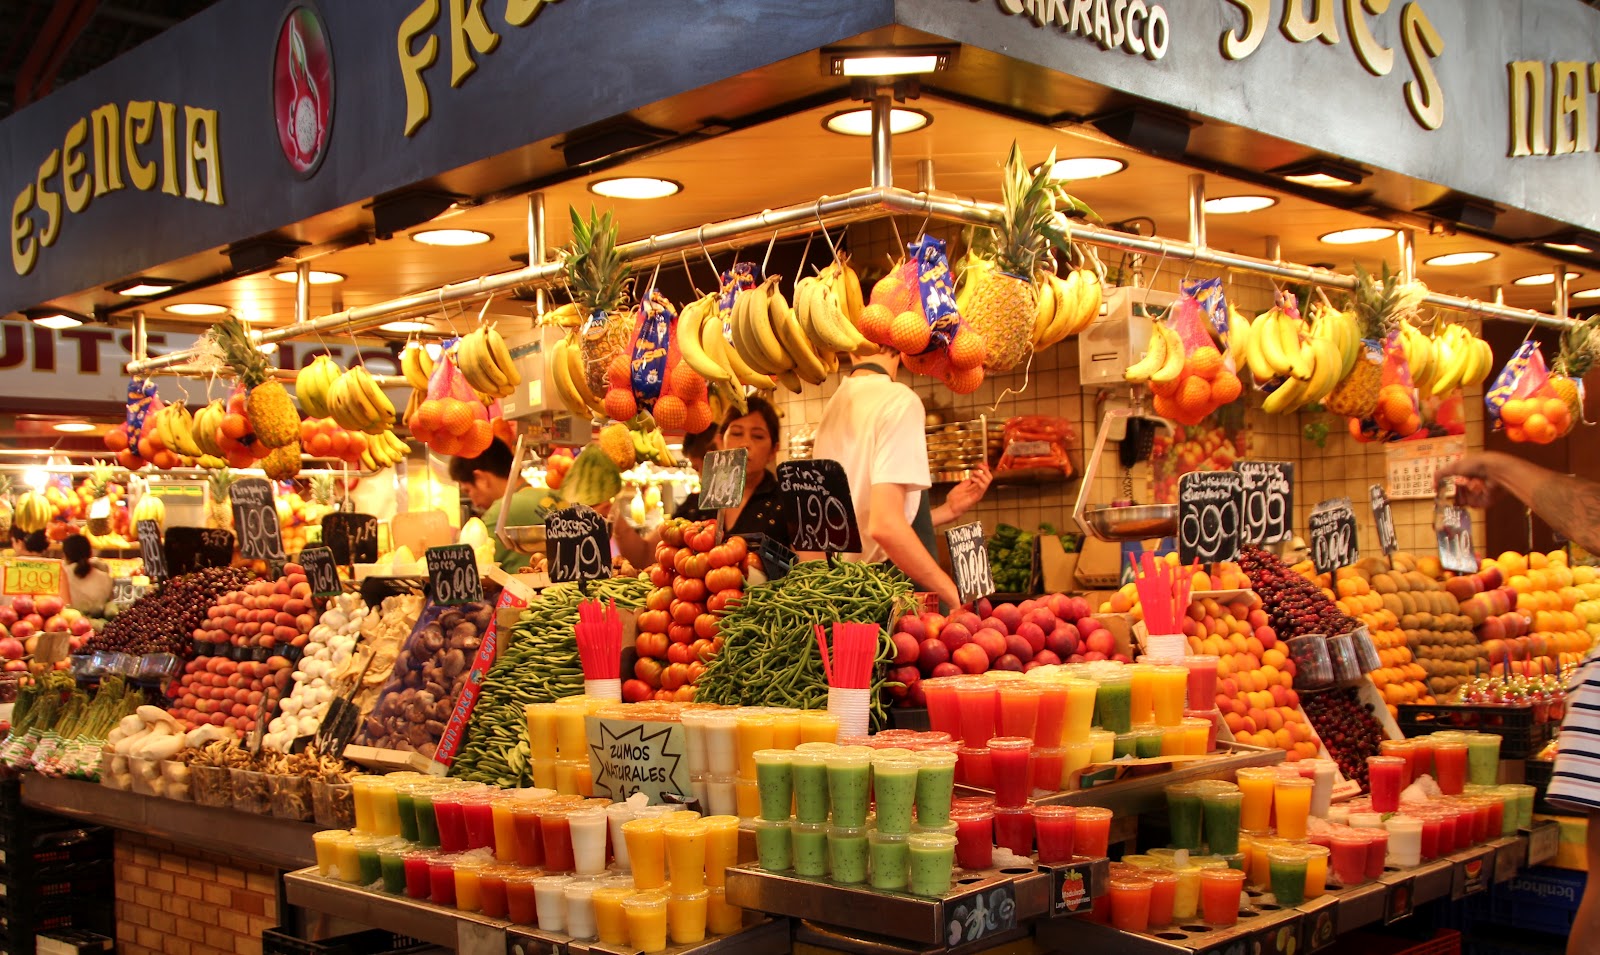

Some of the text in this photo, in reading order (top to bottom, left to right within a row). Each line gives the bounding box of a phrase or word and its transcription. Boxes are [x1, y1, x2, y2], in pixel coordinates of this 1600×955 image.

[1508, 60, 1600, 158] NA
[11, 100, 225, 276] ESENCIA
[604, 761, 666, 783] NATURALES
[609, 743, 650, 761] ZUMOS
